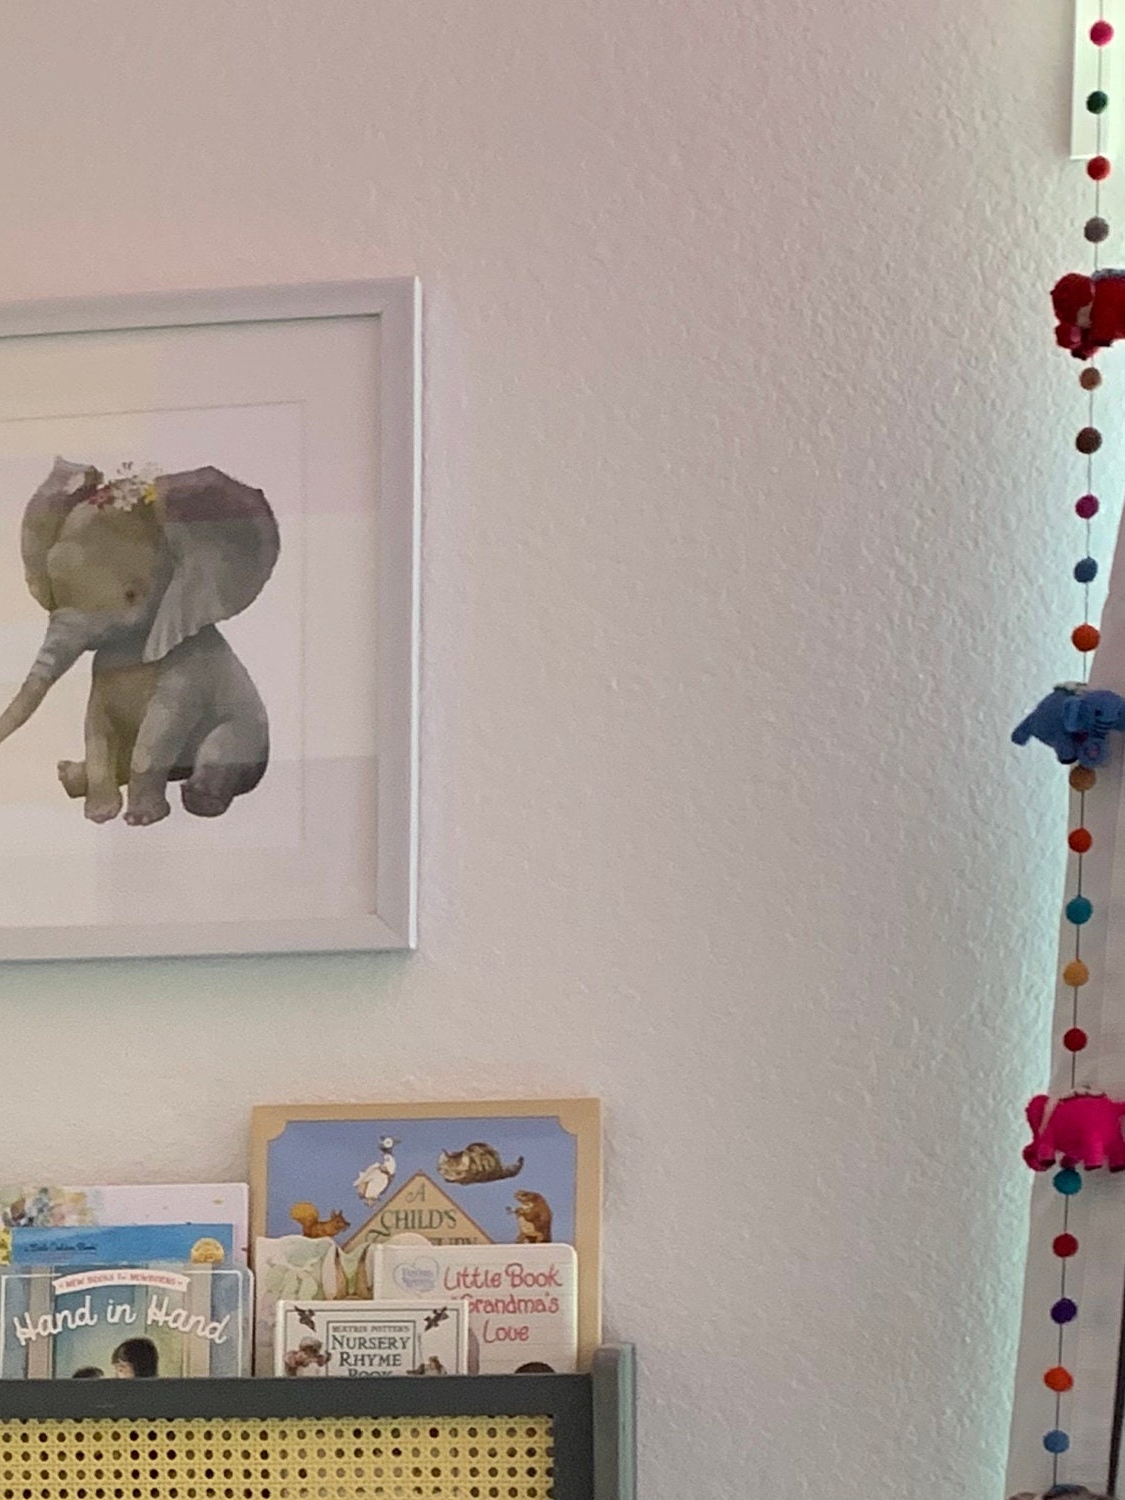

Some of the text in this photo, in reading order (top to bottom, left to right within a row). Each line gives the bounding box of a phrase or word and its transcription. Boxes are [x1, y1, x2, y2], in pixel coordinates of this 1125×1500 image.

[380, 1209, 457, 1229] CHILD'S
[443, 1266, 502, 1290] Little
[505, 1263, 563, 1289] Book
[13, 1294, 231, 1345] Hand in Hand
[331, 1334, 411, 1350] NURSERY
[482, 1319, 530, 1344] Love
[339, 1351, 402, 1367] RHYME
